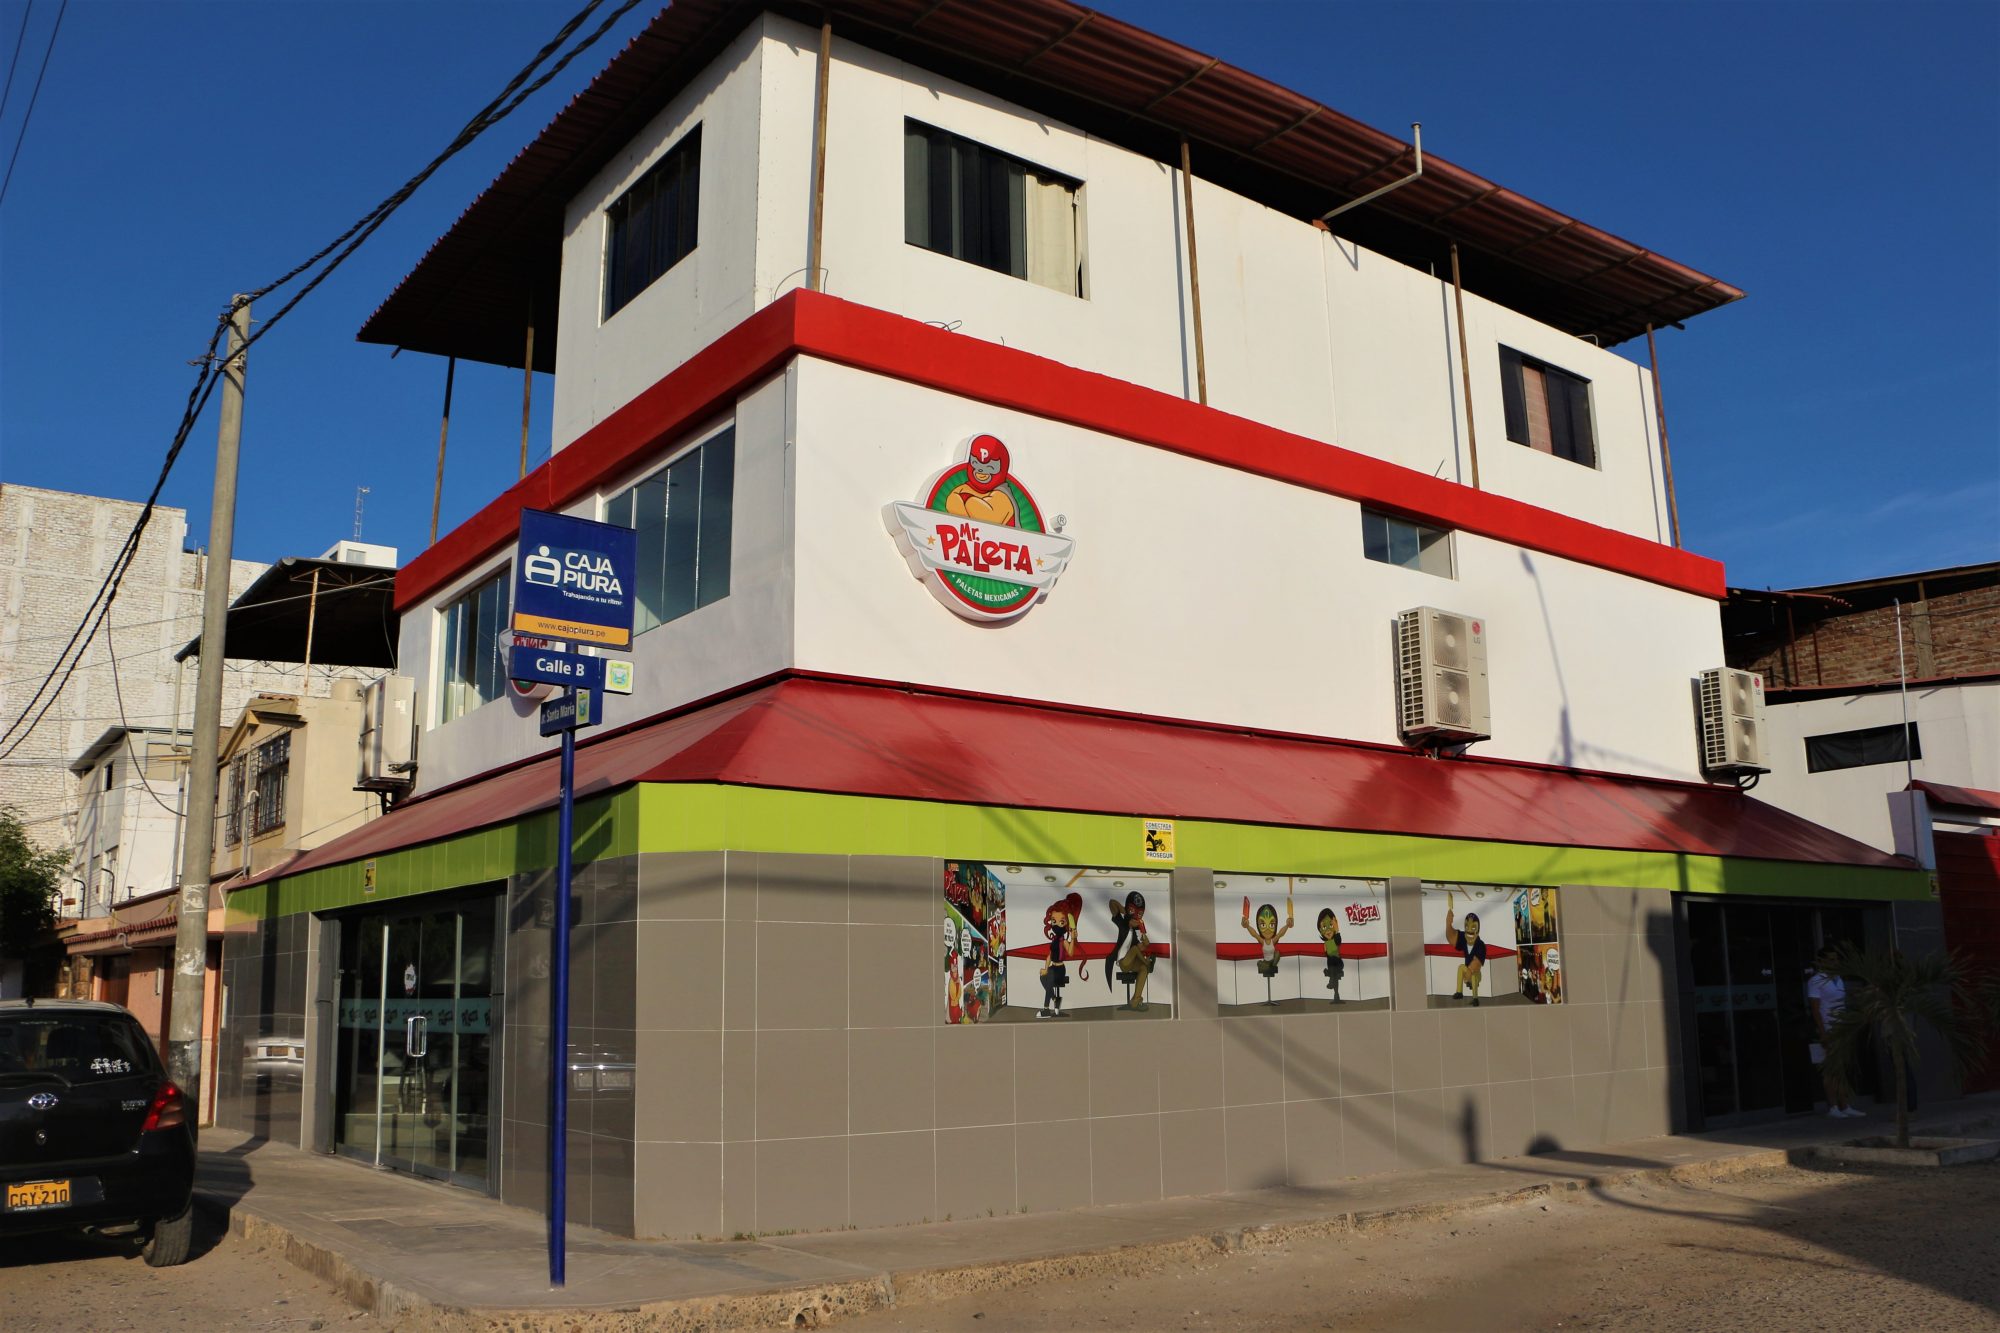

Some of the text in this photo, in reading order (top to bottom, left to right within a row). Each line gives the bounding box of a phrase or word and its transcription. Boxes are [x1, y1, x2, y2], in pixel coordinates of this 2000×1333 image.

[960, 523, 980, 541] Mr.
[565, 551, 614, 576] CAJA
[563, 569, 623, 595] PIURA
[956, 577, 1019, 602] PALETAS MEXICANAS
[563, 590, 595, 603] Trabajando
[537, 622, 606, 637] www.cajapiura.pe
[536, 658, 585, 676] Calle B
[546, 707, 560, 723] Santa
